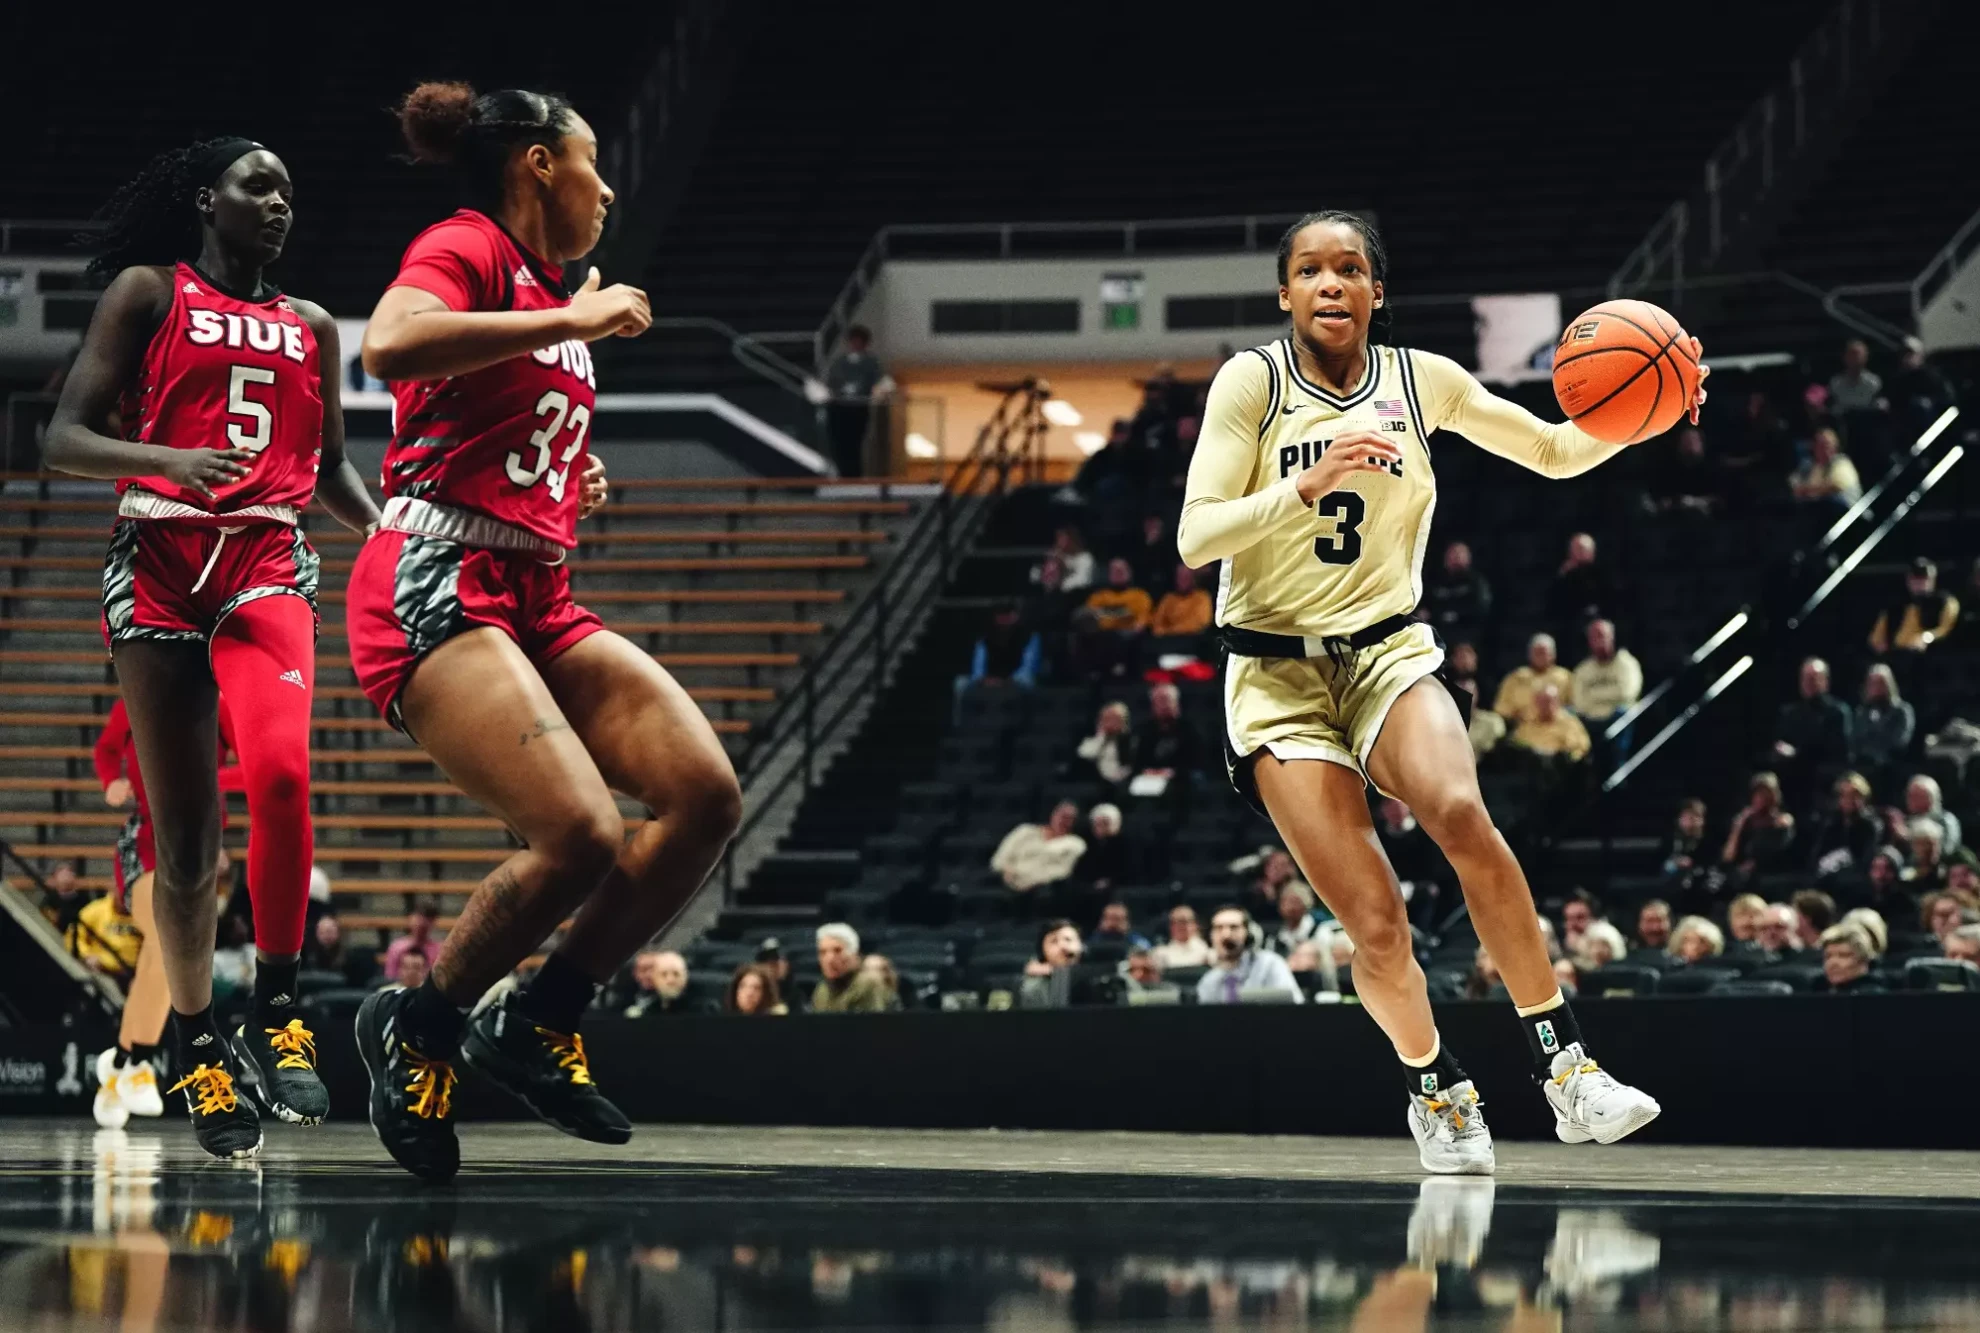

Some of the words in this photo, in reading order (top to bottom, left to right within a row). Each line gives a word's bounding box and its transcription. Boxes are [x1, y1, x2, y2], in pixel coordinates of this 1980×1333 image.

[187, 308, 306, 364] SIUE
[226, 364, 276, 453] 5
[505, 389, 590, 503] 33
[1280, 439, 1403, 479] PUE
[1314, 490, 1365, 565] 3
